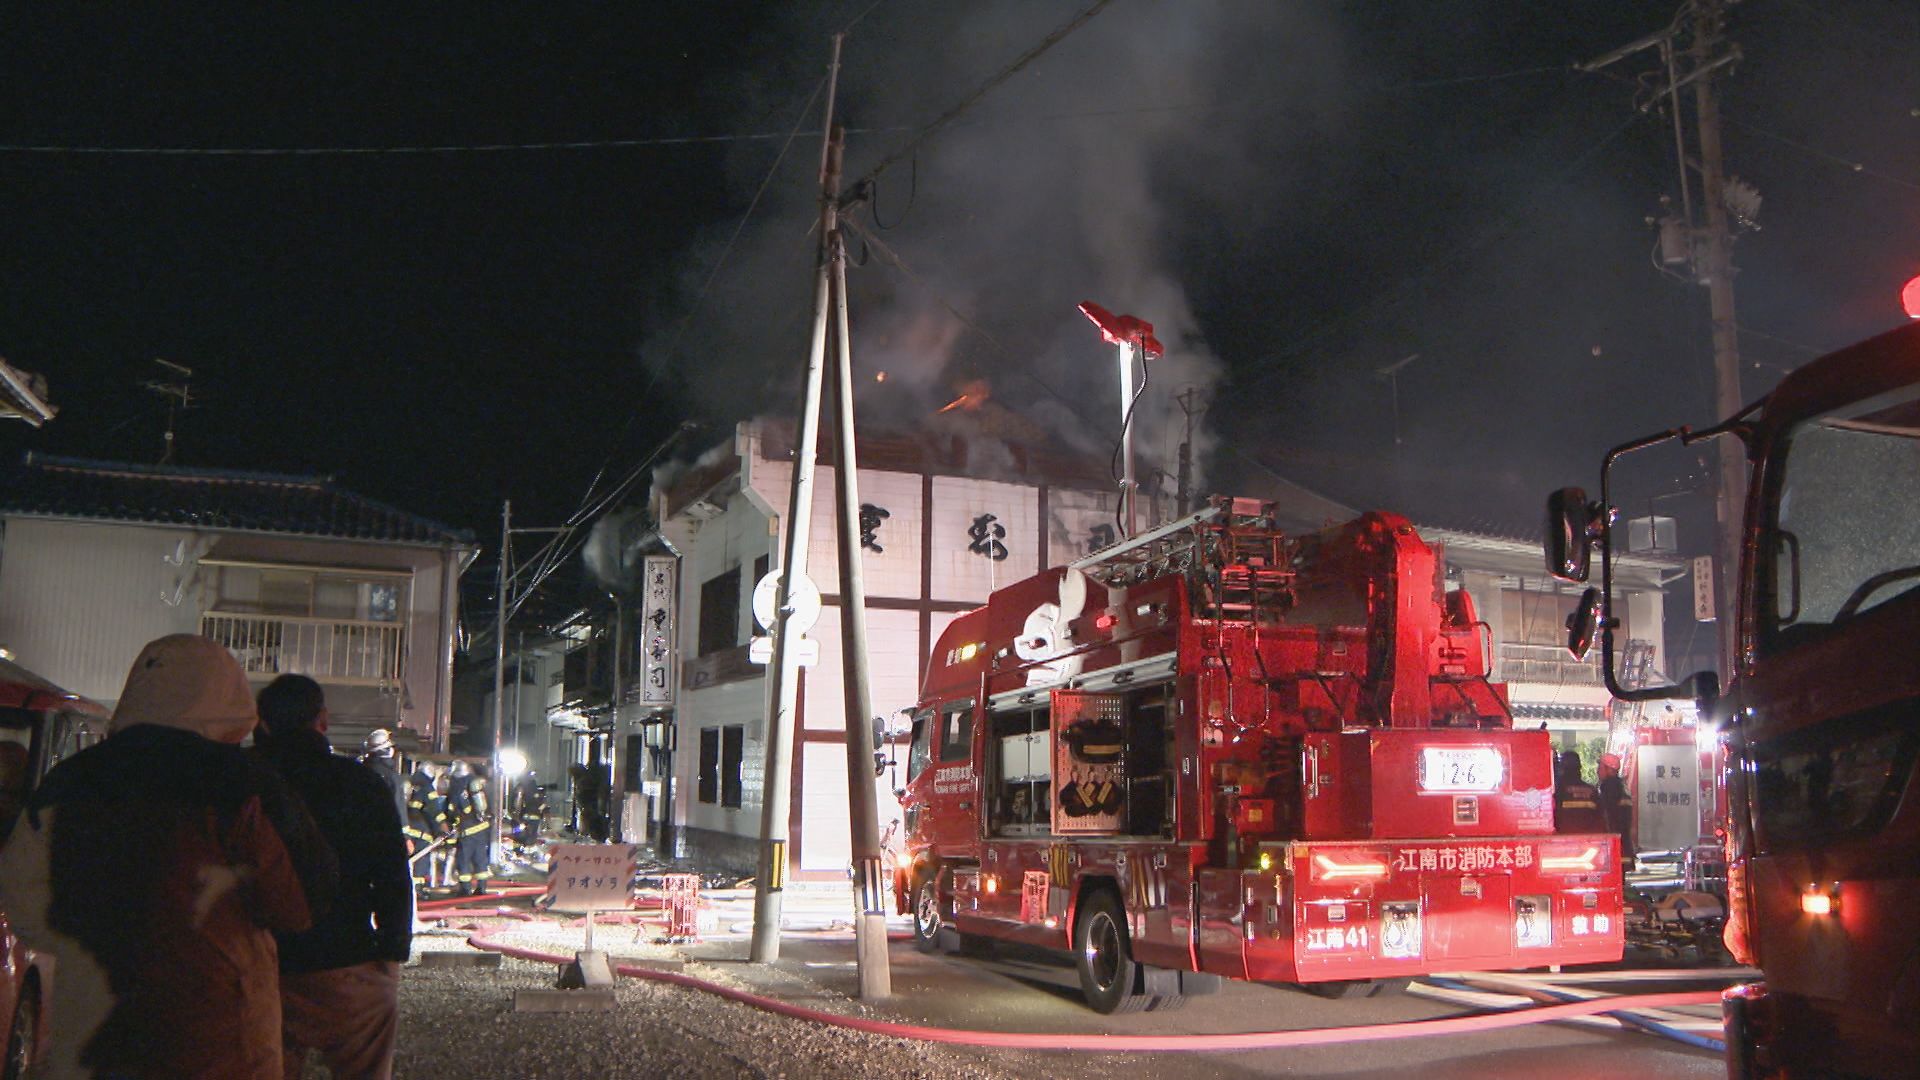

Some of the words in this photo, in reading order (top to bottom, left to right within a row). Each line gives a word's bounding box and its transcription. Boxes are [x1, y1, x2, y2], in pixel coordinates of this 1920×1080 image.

[1655, 764, 1681, 780] 愛知
[1646, 791, 1691, 807] 江南消防
[1398, 844, 1533, 872] 江南市消防本部
[1306, 925, 1369, 950] 江南41
